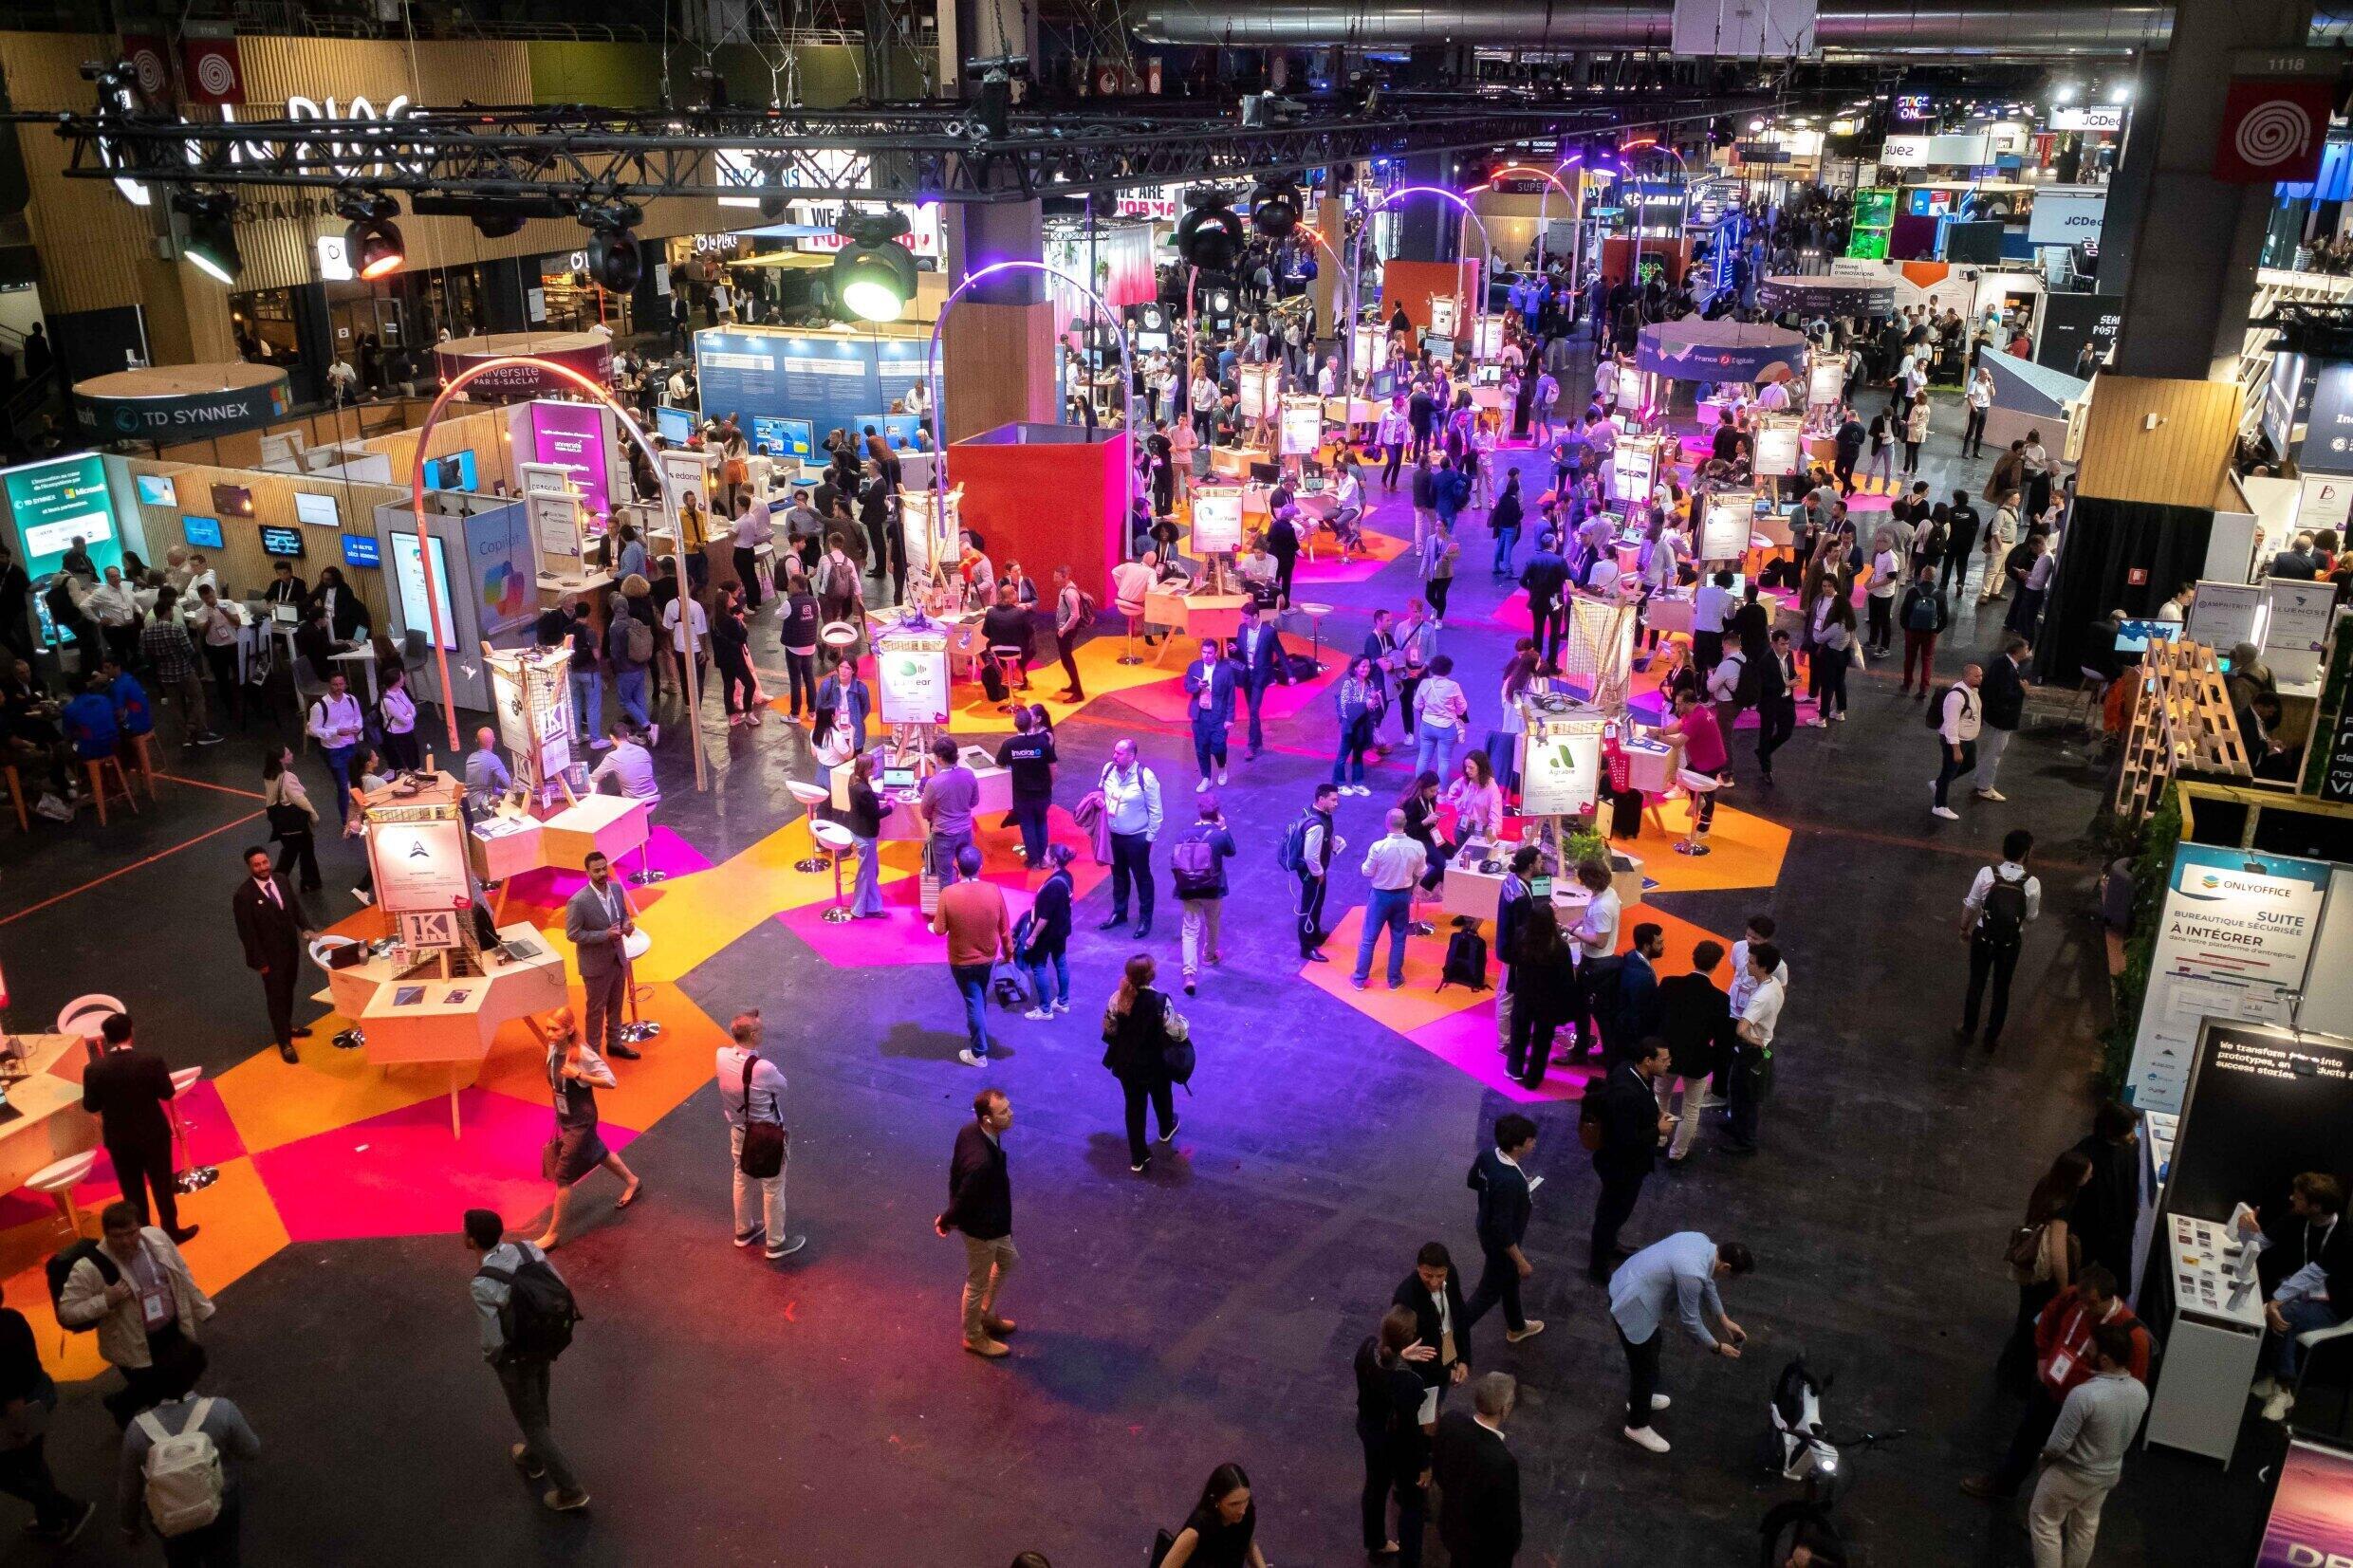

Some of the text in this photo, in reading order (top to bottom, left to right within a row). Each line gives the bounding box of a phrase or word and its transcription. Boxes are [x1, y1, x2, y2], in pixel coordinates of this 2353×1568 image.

[1884, 145, 1915, 157] suez
[1139, 185, 1164, 199] ARE
[1695, 354, 1718, 363] France
[143, 411, 169, 426] TD
[174, 401, 250, 425] SYNNEX
[2206, 600, 2252, 612] AMPHITRITE
[2271, 605, 2327, 617] BLUENOSE
[2223, 880, 2292, 898] ONLYOFFICE
[2174, 910, 2303, 936] BUREAUTIQUE SÉCURISÉE
[2256, 911, 2306, 928] SUITE
[2171, 921, 2264, 947] À INTÉGRER
[2168, 933, 2297, 960] dans votre plateforme d'entreprise
[2236, 1043, 2287, 1059] transform
[2215, 1060, 2297, 1080] success stories.
